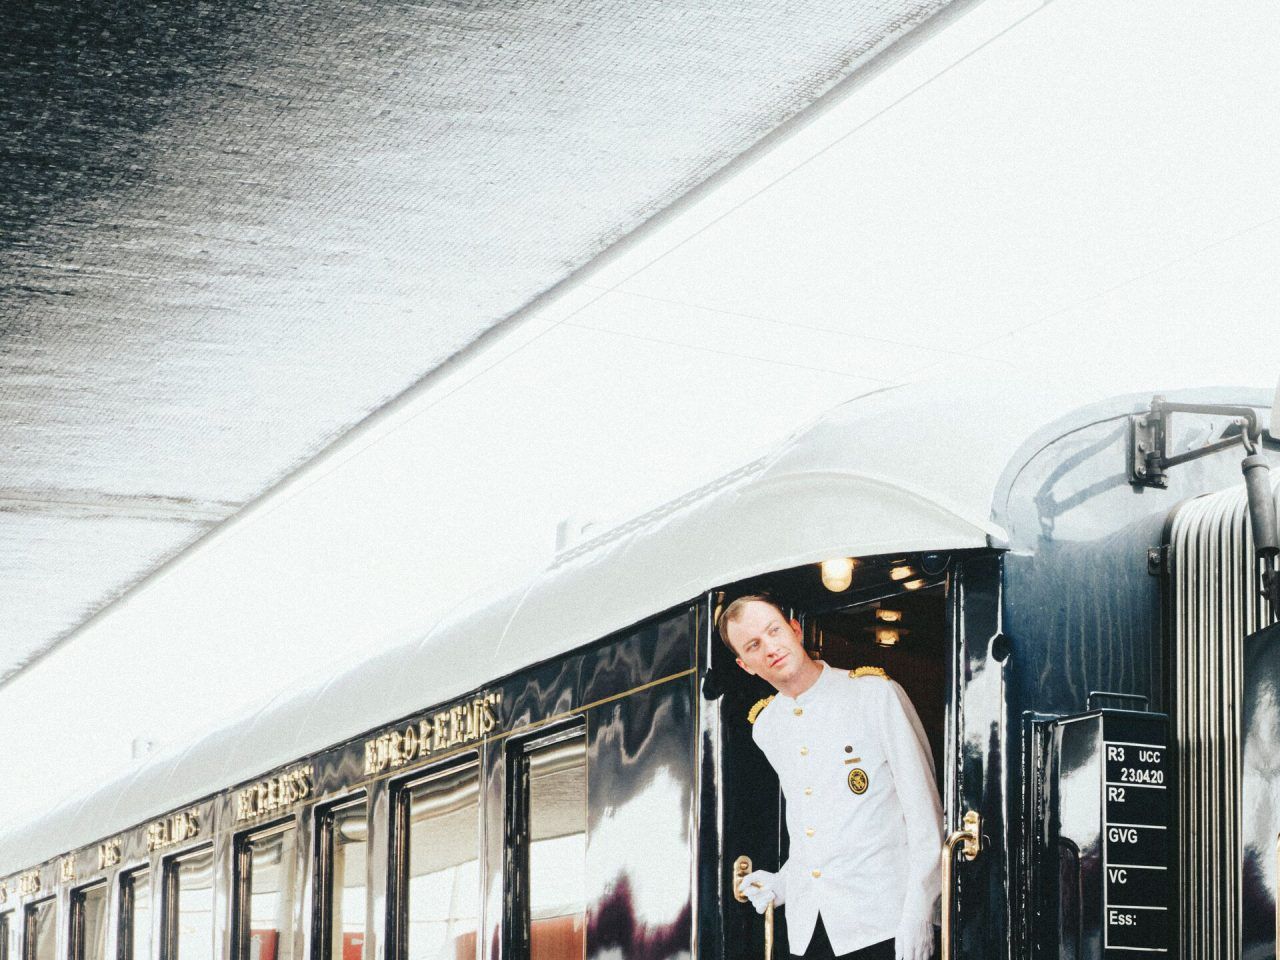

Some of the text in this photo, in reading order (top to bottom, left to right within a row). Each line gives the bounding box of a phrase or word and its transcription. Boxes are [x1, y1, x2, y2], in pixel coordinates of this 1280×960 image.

[1107, 746, 1161, 763] R3 UCC
[1120, 767, 1164, 784] 23.04.20
[1108, 787, 1125, 802] R2
[1108, 828, 1138, 843] GVG
[1108, 869, 1127, 884] VC
[1109, 910, 1137, 926] Ess:
